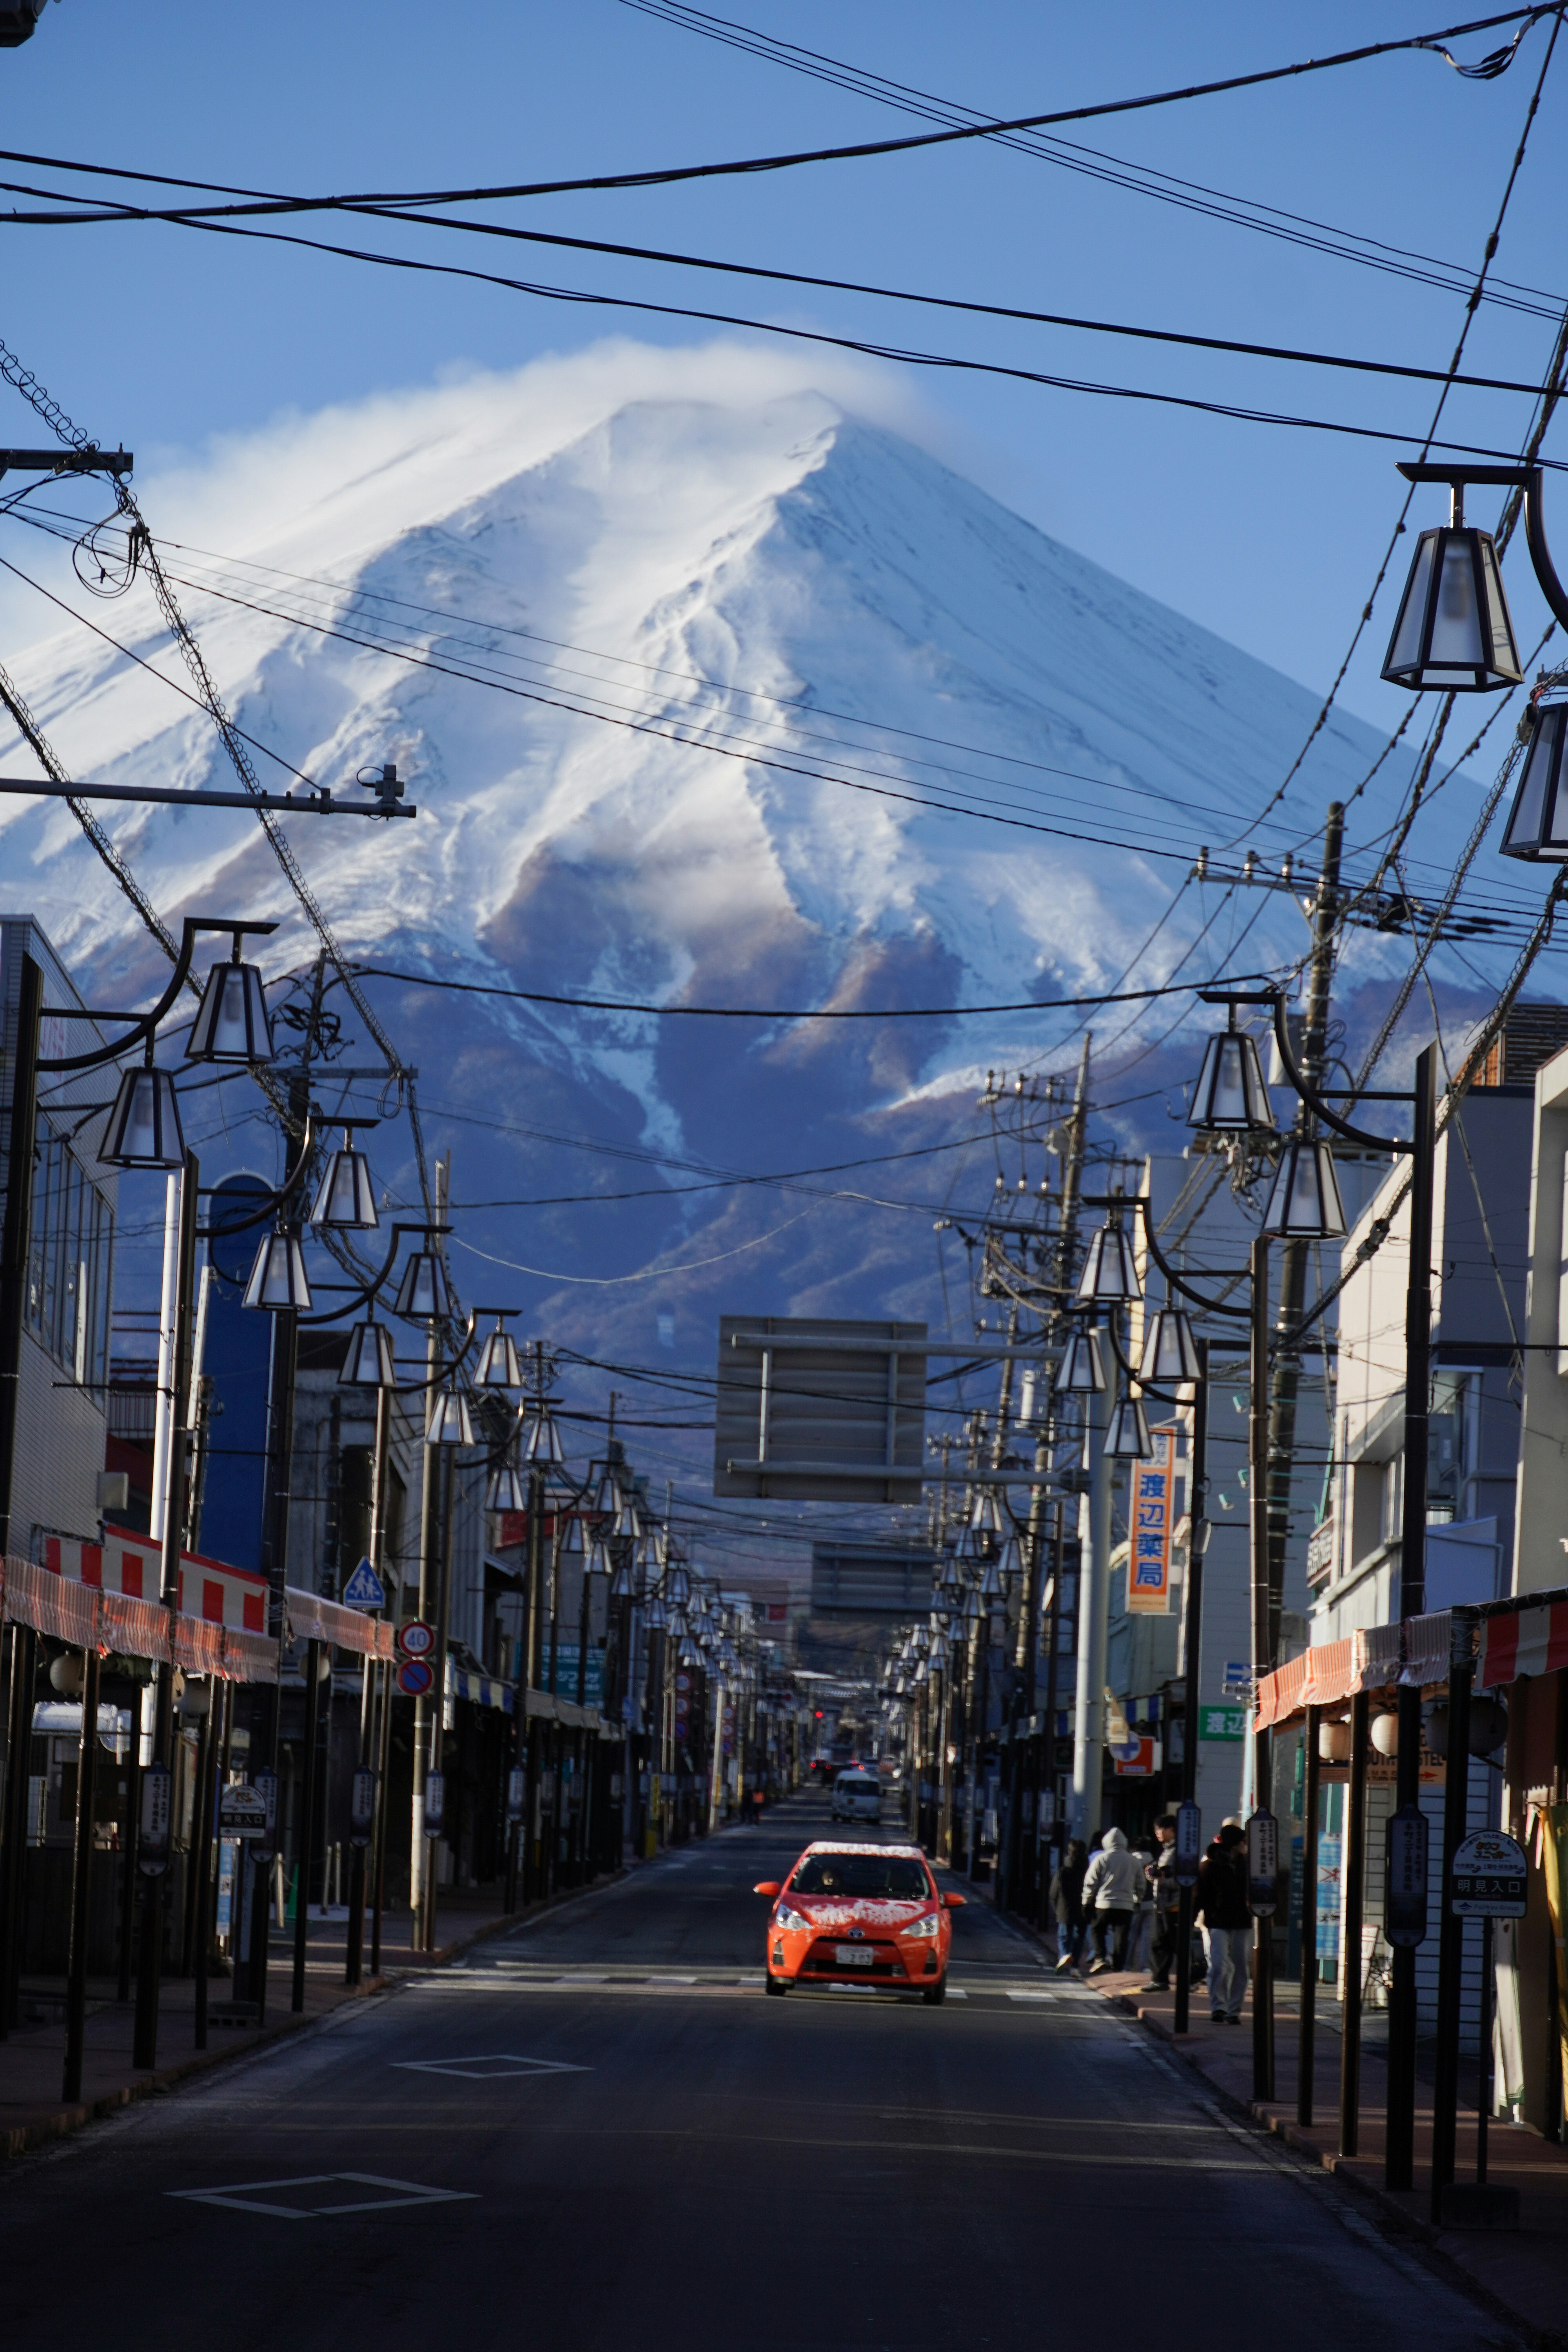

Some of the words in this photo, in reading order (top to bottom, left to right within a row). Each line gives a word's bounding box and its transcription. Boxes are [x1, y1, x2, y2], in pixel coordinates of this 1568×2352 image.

[1136, 1474, 1166, 1588] 渡辺薬局
[407, 1632, 426, 1647] 40
[1457, 1880, 1520, 1893] 明見入口
